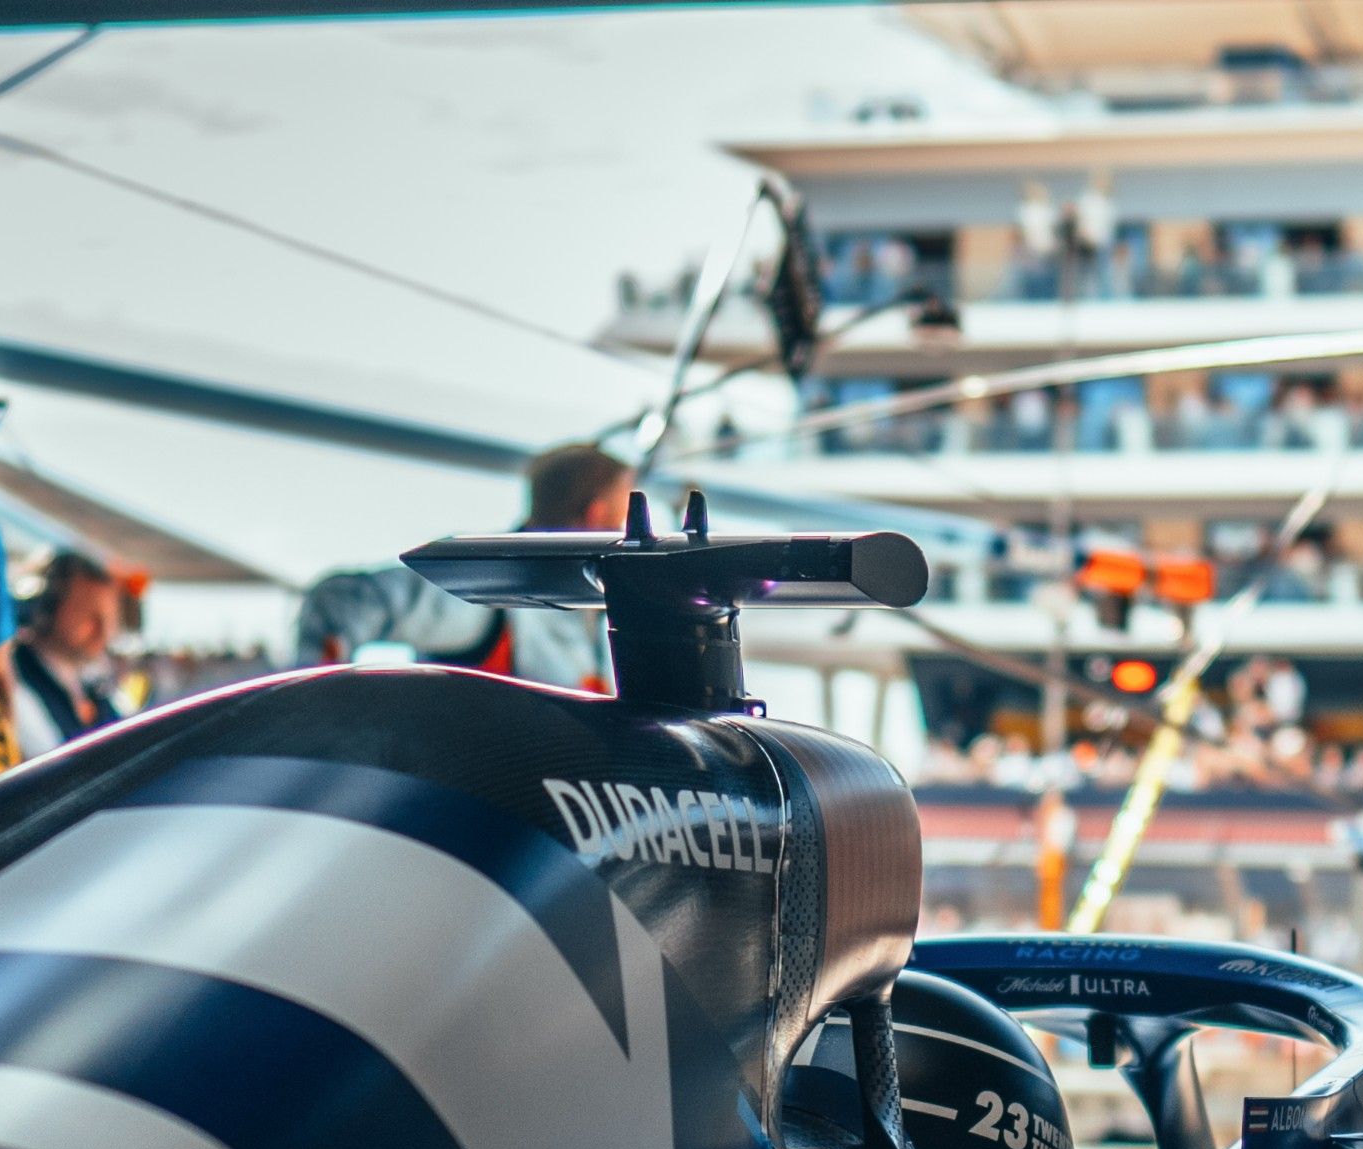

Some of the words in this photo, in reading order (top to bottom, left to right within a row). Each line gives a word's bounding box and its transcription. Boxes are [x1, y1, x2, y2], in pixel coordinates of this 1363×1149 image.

[542, 778, 773, 875] DURACELL
[1015, 946, 1141, 962] RACING
[1084, 978, 1151, 996] ULTRA
